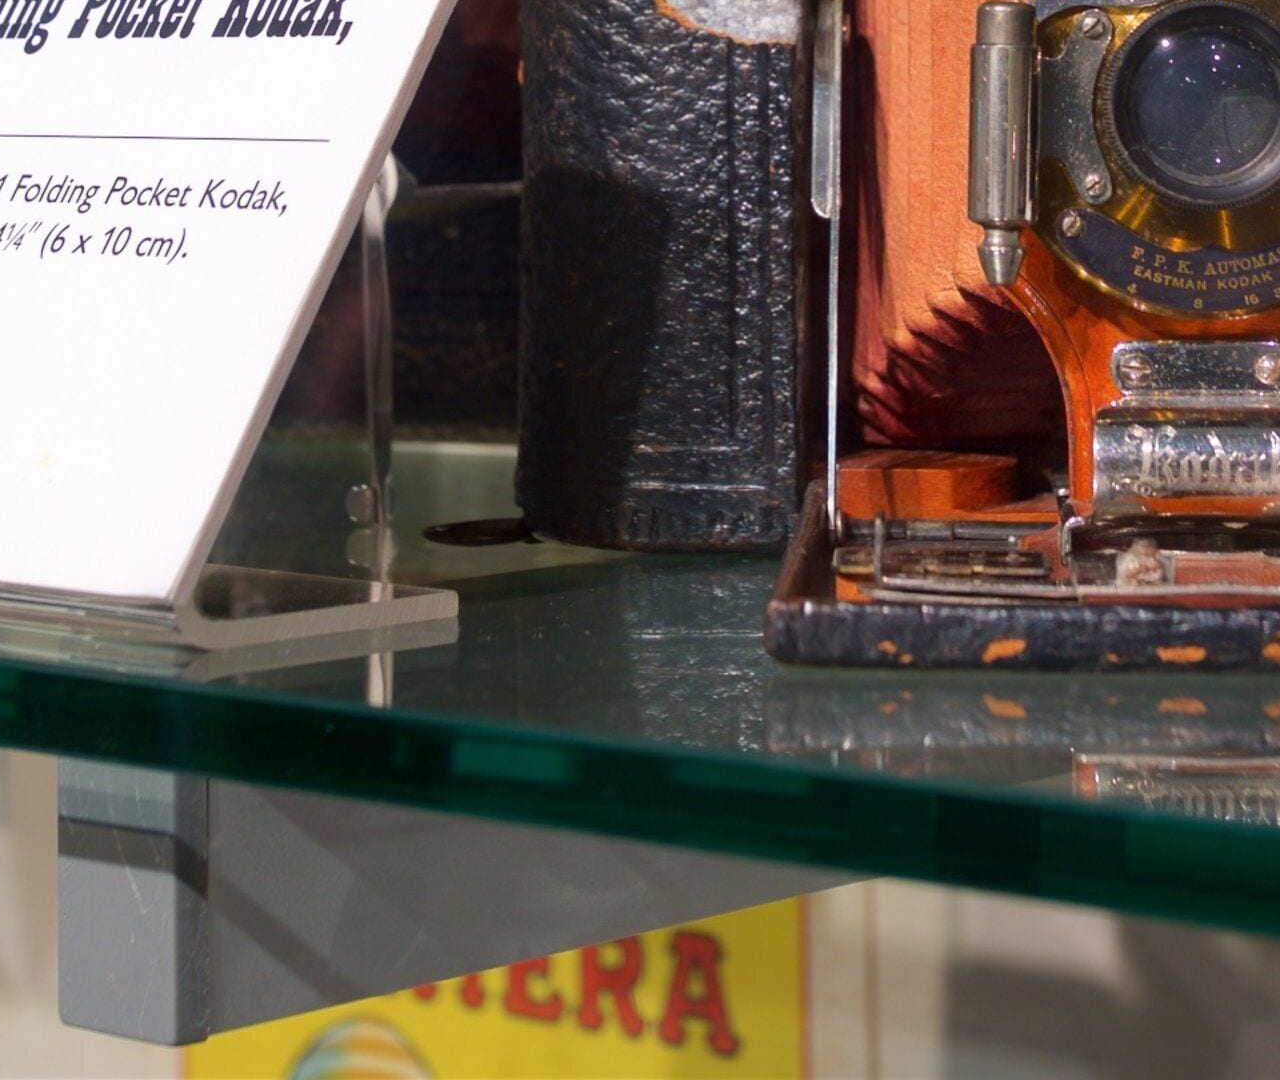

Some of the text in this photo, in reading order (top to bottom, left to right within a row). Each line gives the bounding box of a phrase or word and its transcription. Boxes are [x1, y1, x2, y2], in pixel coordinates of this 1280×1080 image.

[10, 174, 100, 214] Folding
[104, 176, 192, 207] Pocket
[198, 179, 288, 217] Kodak,
[40, 223, 70, 259] (6
[71, 234, 93, 254] x
[101, 227, 132, 255] 10
[135, 227, 188, 265] cm).
[1132, 265, 1207, 291] EASTMAN
[1217, 272, 1273, 291] KODAK
[1243, 293, 1260, 307] 16
[412, 929, 741, 1058] ERA
